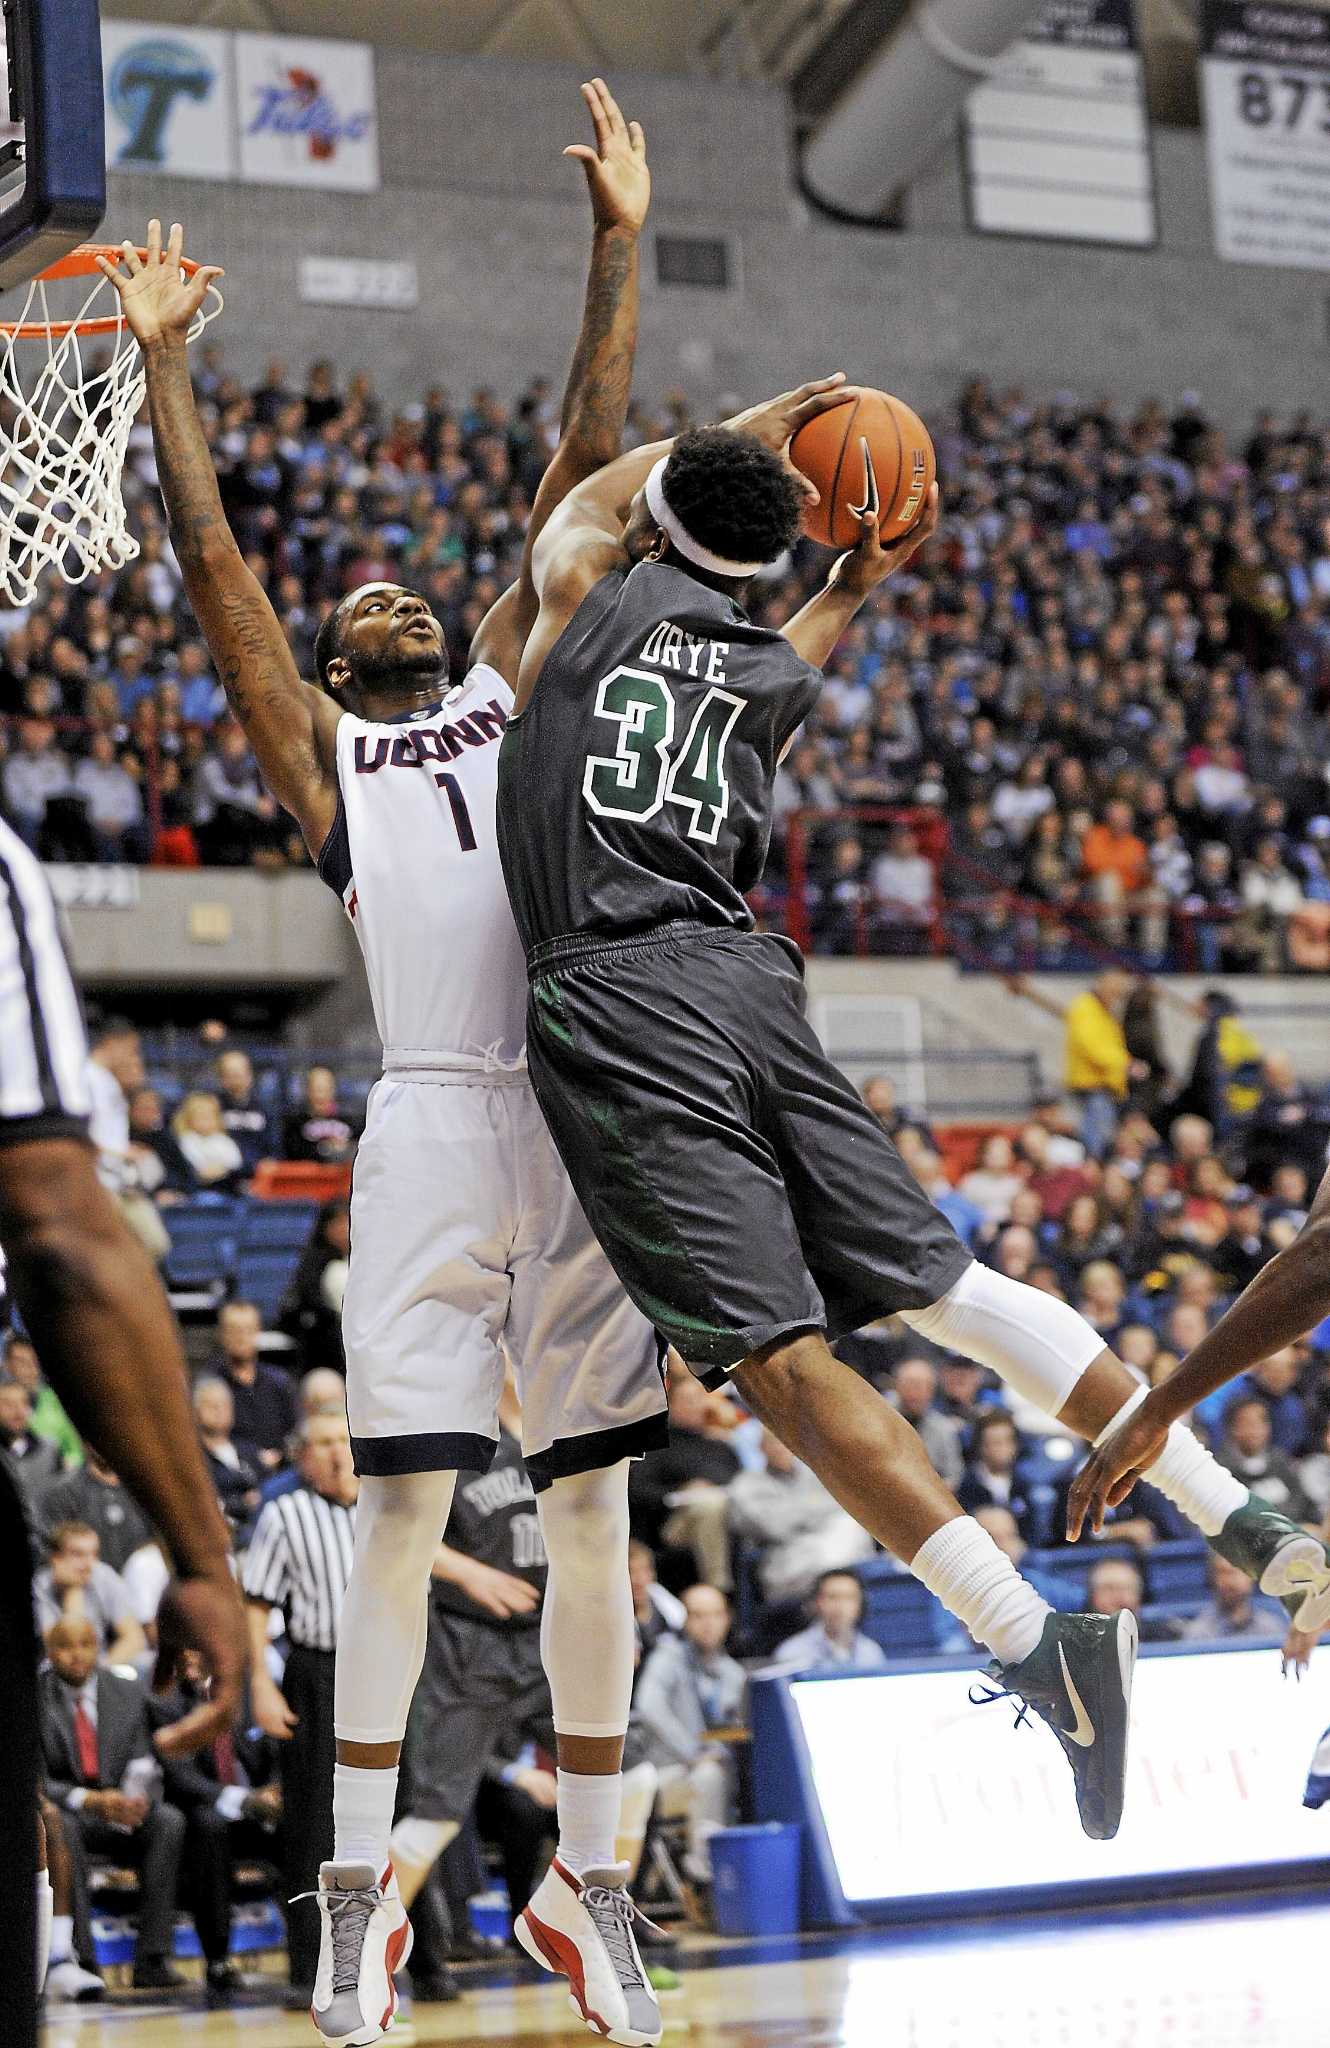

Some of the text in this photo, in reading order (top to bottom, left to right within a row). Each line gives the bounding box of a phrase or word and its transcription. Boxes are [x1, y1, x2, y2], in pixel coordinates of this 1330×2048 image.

[639, 620, 729, 684] DRYE
[354, 699, 508, 774] UCONN
[582, 665, 748, 845] 34
[434, 772, 478, 852] 1
